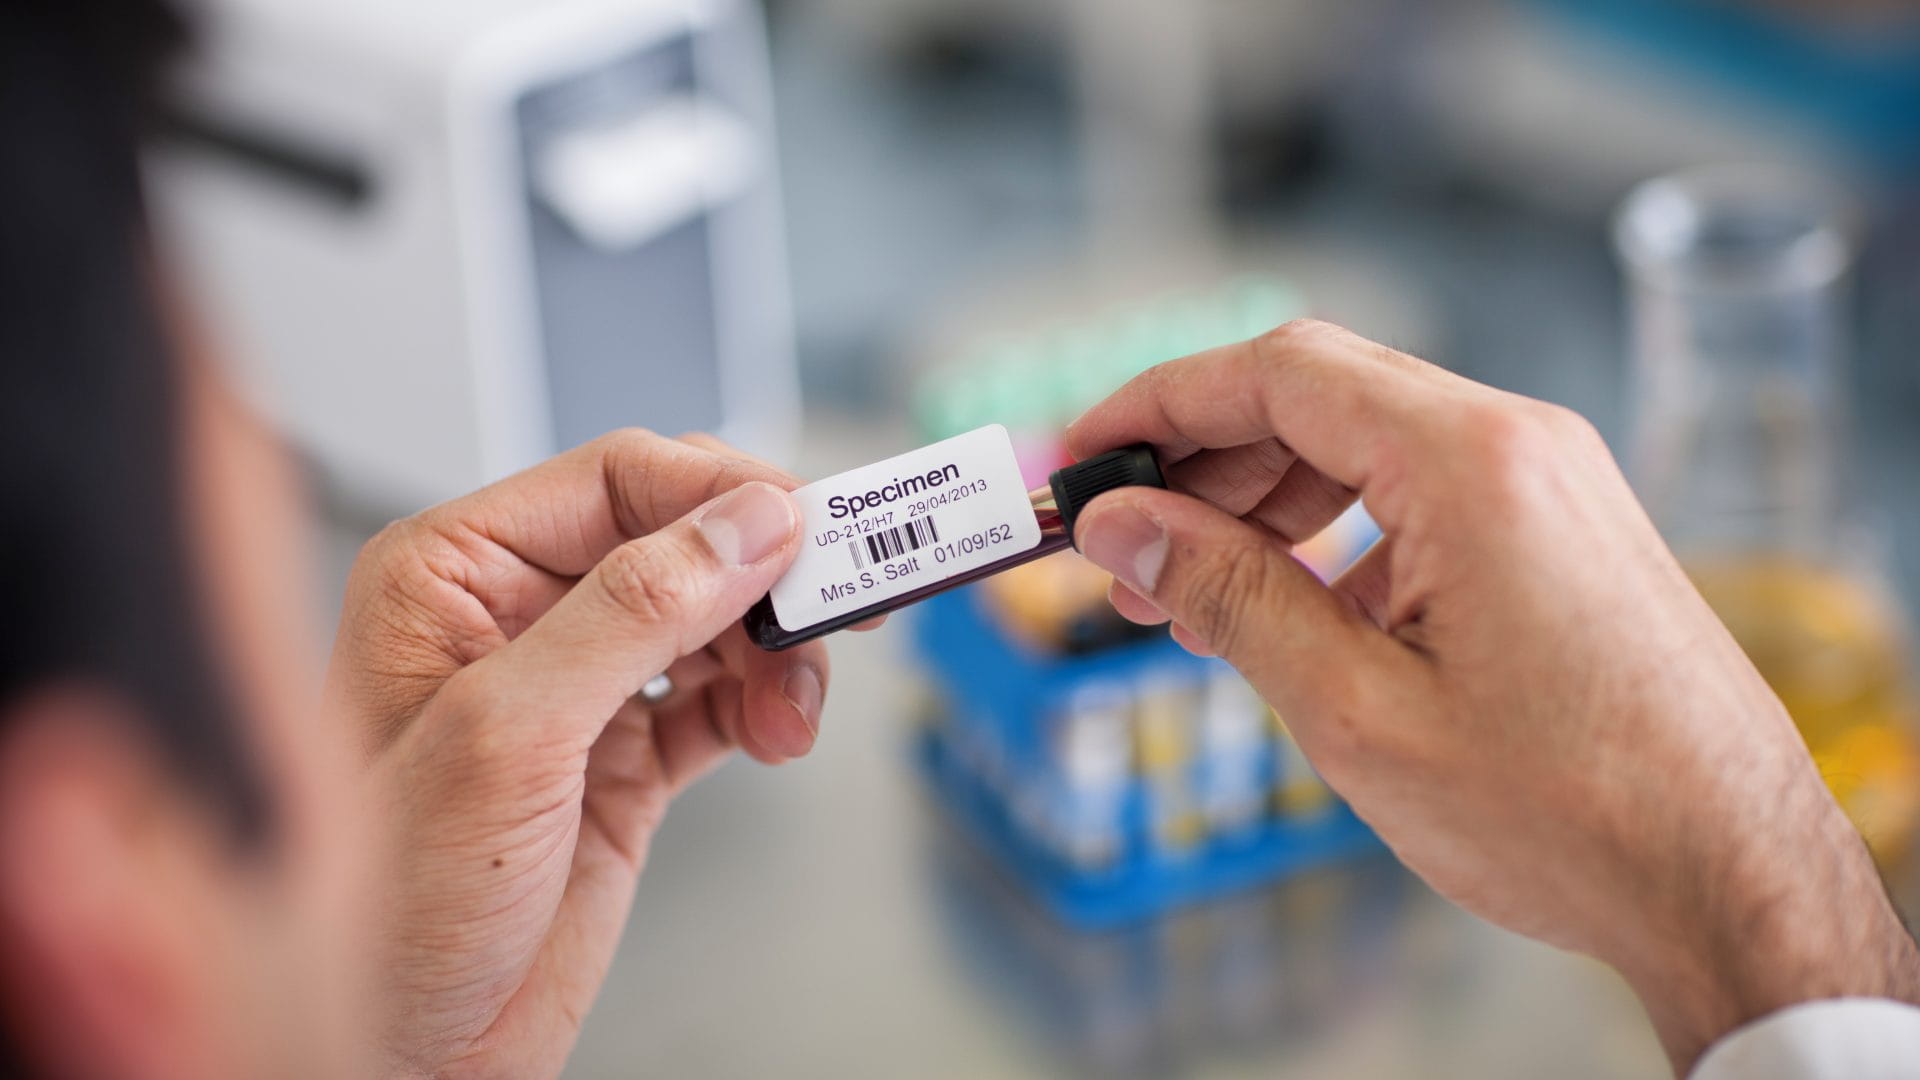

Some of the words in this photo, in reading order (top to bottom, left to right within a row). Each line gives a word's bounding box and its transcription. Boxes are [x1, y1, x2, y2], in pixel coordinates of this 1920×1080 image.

[815, 511, 894, 547] UD-212/H7
[908, 479, 988, 517] 29/04/2013
[828, 463, 960, 519] Specimen
[820, 580, 856, 603] Mrs
[860, 572, 880, 589] S.
[884, 556, 920, 581] Salt
[934, 524, 1013, 563] 01/09/52
